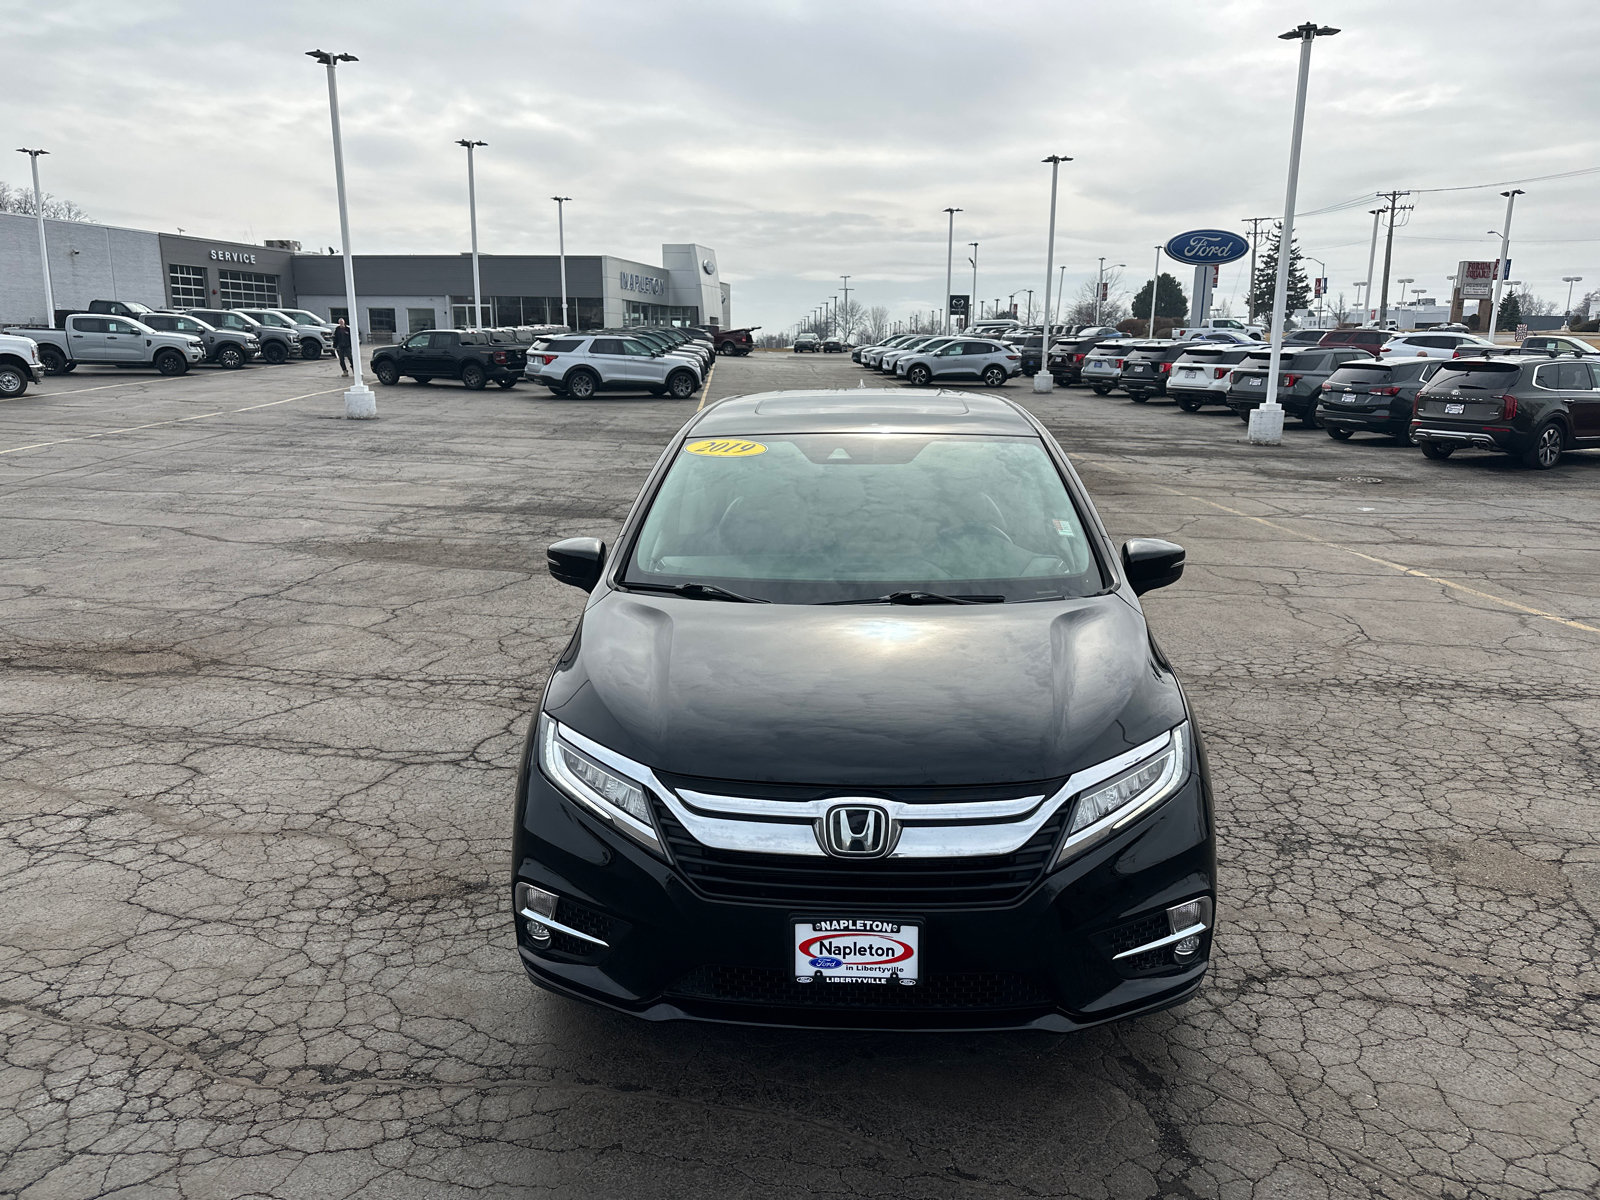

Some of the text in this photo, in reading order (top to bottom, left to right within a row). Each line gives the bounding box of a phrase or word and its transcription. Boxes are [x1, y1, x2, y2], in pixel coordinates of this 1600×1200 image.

[1184, 236, 1233, 256] Ford
[210, 249, 256, 264] SERVICE
[1467, 262, 1491, 270] FORUM
[1466, 270, 1491, 280] SQUARE
[620, 271, 664, 296] NAPLETON
[694, 442, 756, 453] 2019
[821, 920, 892, 932] NAPLETON
[819, 941, 895, 959] Napleton
[815, 959, 836, 967] Ford
[856, 965, 904, 973] Libertyville
